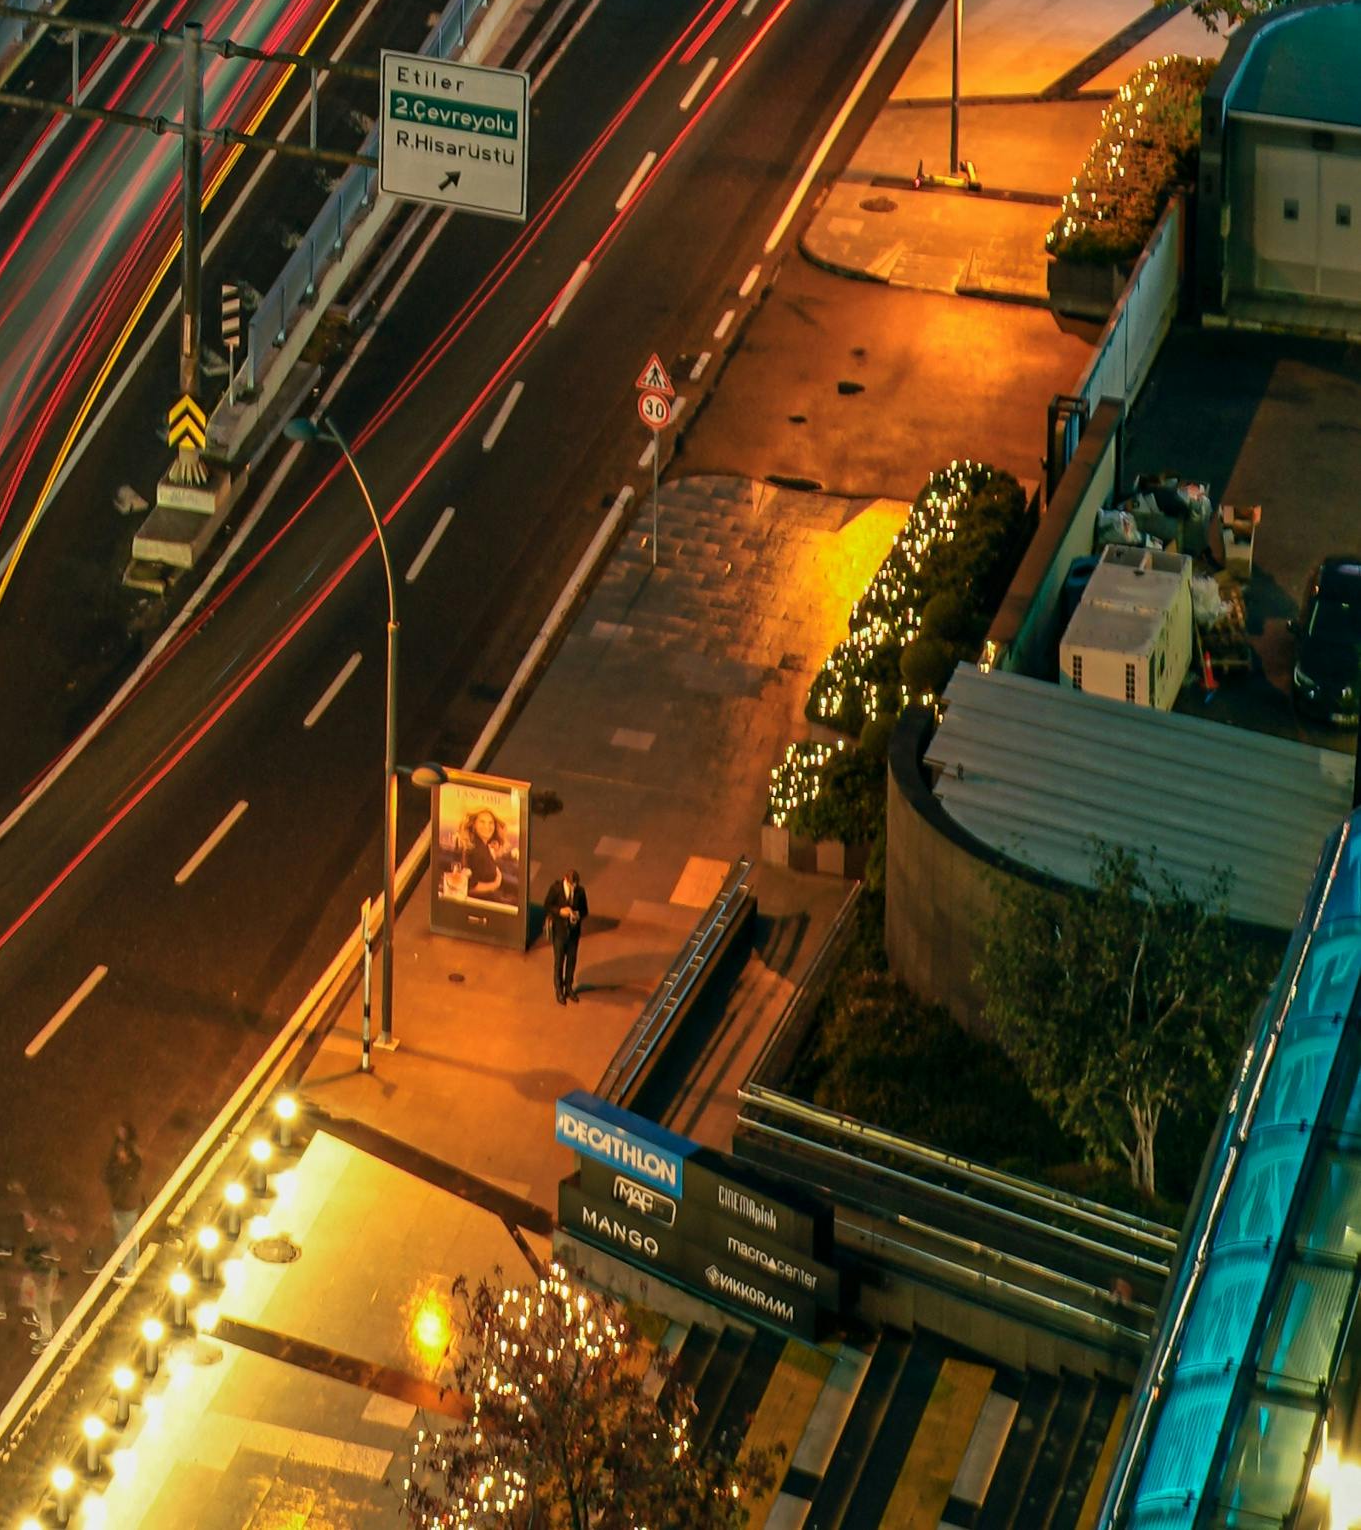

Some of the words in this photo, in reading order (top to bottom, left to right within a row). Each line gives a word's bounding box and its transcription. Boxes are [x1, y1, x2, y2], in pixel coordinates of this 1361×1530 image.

[397, 66, 465, 93] Etiler
[394, 97, 515, 135] 2.Çevreyolu
[396, 130, 516, 167] R.Hisarüstü
[645, 398, 665, 419] 30
[562, 1115, 676, 1188] DECATHLON
[582, 1206, 659, 1258] MANGO
[719, 1271, 794, 1324] VAKKORAMA
